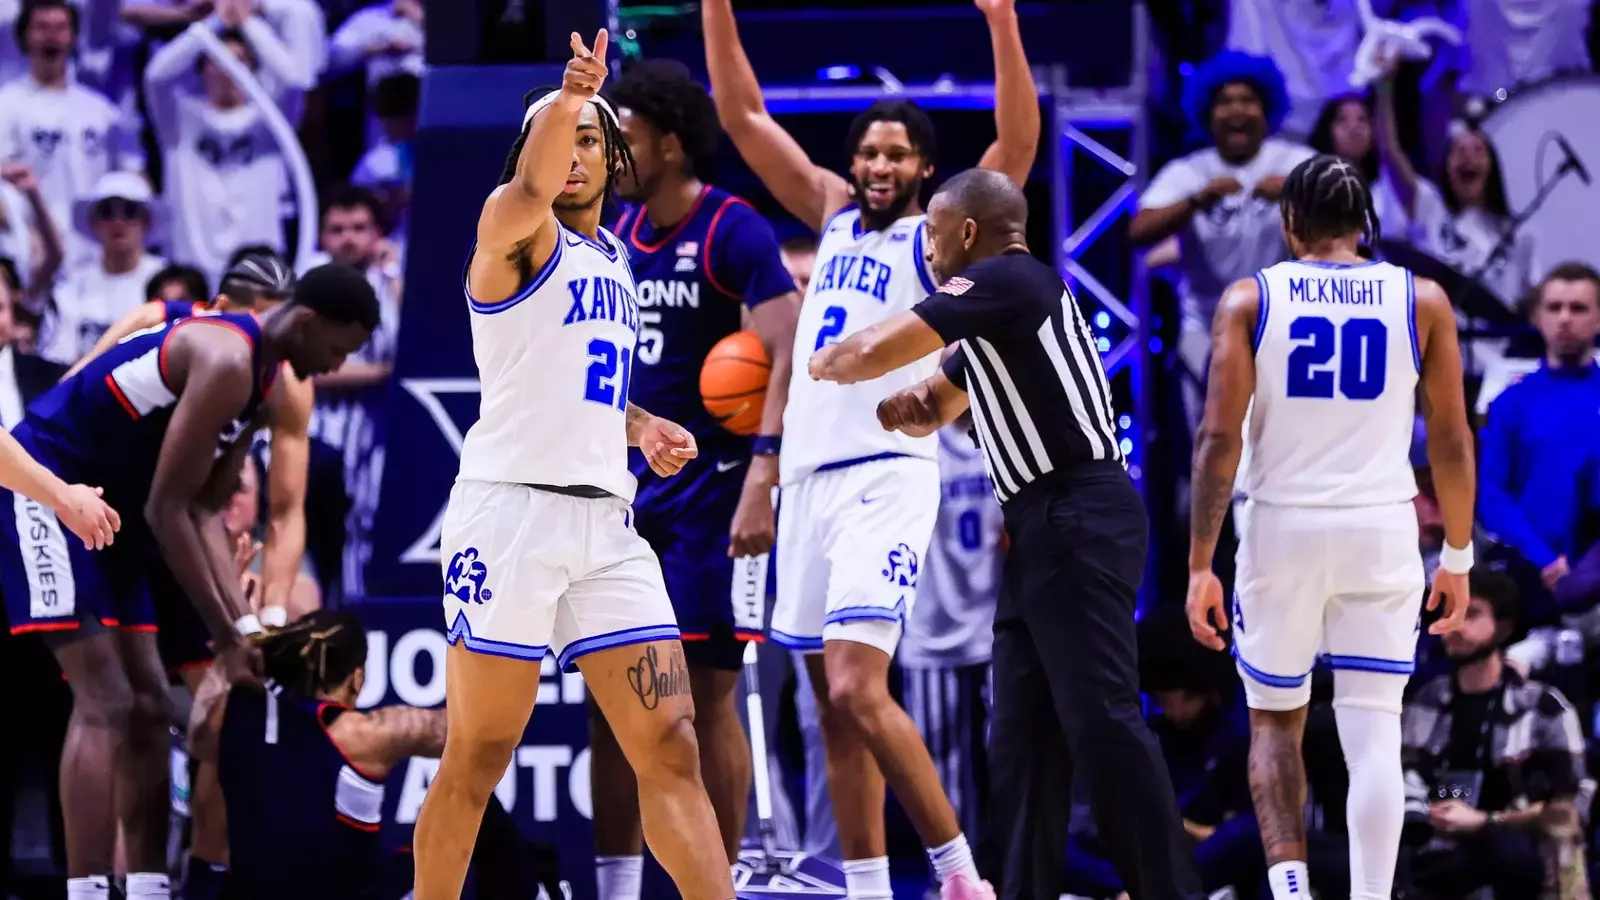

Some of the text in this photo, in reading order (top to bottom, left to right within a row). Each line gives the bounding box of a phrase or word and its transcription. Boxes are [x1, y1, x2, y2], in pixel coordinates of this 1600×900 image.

[562, 275, 641, 334] XAVIE
[638, 279, 700, 308] ONN
[814, 254, 892, 304] AVER
[1288, 277, 1385, 306] MCKNIGHT
[638, 310, 665, 366] 5
[814, 304, 848, 353] 2
[583, 336, 632, 415] 21
[1286, 315, 1388, 401] 20
[26, 497, 59, 608] USKIES
